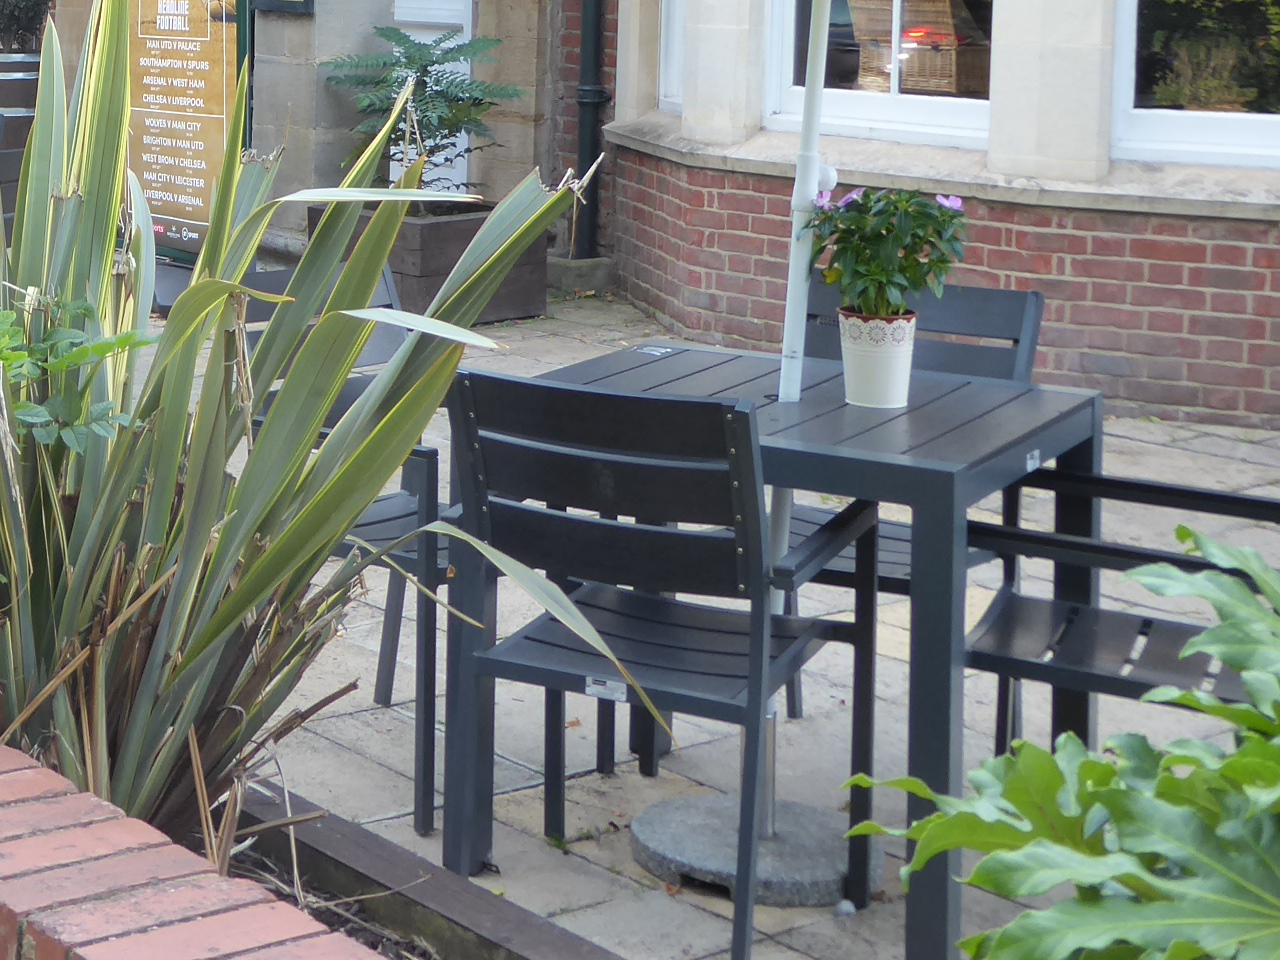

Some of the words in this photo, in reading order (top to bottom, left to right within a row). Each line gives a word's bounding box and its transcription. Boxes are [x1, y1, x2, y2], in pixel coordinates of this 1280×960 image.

[158, 0, 189, 14] HEADLINE
[156, 15, 189, 31] FOOTBALL
[160, 41, 172, 49] UTD
[178, 42, 201, 51] PALACE
[139, 57, 182, 69] SOUTHAMPTON
[188, 60, 209, 70] SPURS
[143, 75, 167, 86] ARSENAL
[172, 78, 188, 87] WEST
[189, 79, 205, 88] HAM
[143, 94, 167, 103] CHELSEA
[172, 96, 205, 107] LIVERPOOL
[145, 118, 167, 127] WOLVES
[172, 121, 185, 129] MAN
[187, 122, 201, 131] CITY
[143, 135, 171, 147] BRIGHTON
[177, 140, 190, 149] MAN
[191, 141, 204, 150] UTD
[142, 153, 157, 163] WEST
[158, 155, 175, 165] BROM
[180, 157, 206, 169] CHELSEA
[143, 171, 157, 180] MAN
[157, 173, 171, 182] CITY
[175, 175, 204, 188] LEICESTER
[144, 190, 174, 202] LIVERPOOL
[178, 194, 204, 206] ARSENAL
